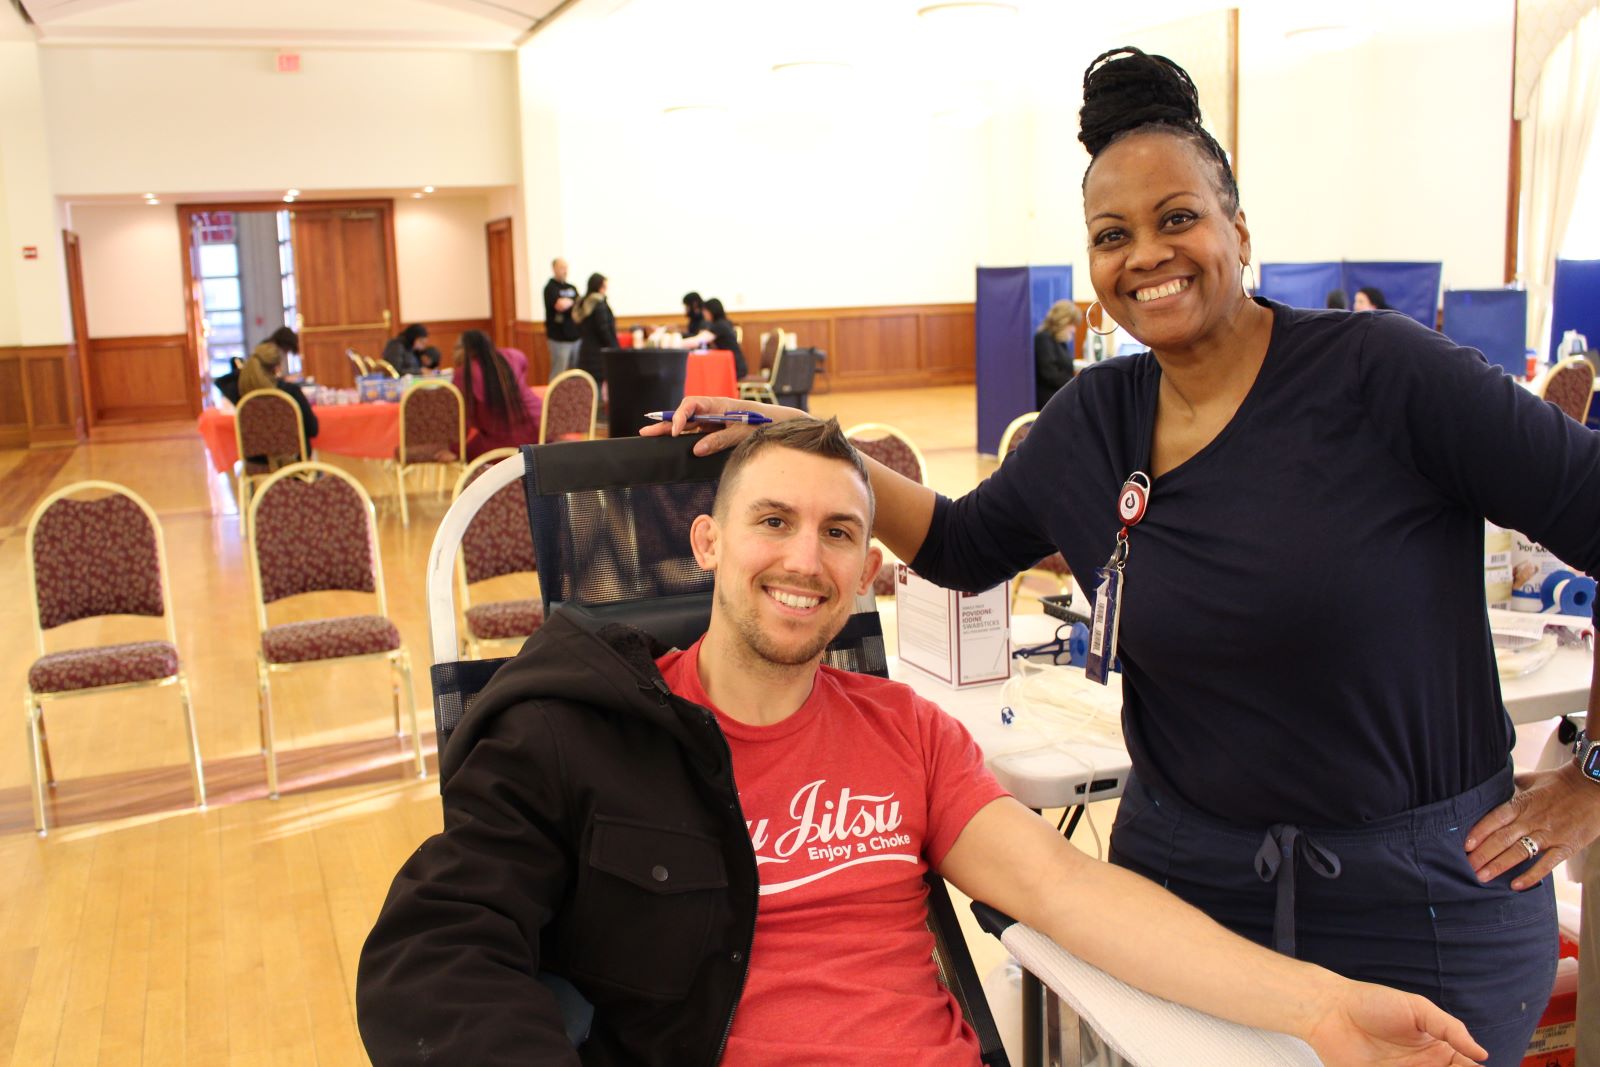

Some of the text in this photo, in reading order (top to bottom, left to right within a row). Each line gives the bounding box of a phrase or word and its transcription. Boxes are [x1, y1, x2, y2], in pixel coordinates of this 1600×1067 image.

[962, 608, 992, 617] POVIDONE
[774, 780, 902, 857] Jitsu
[808, 834, 910, 861] Enjoy a Choke
